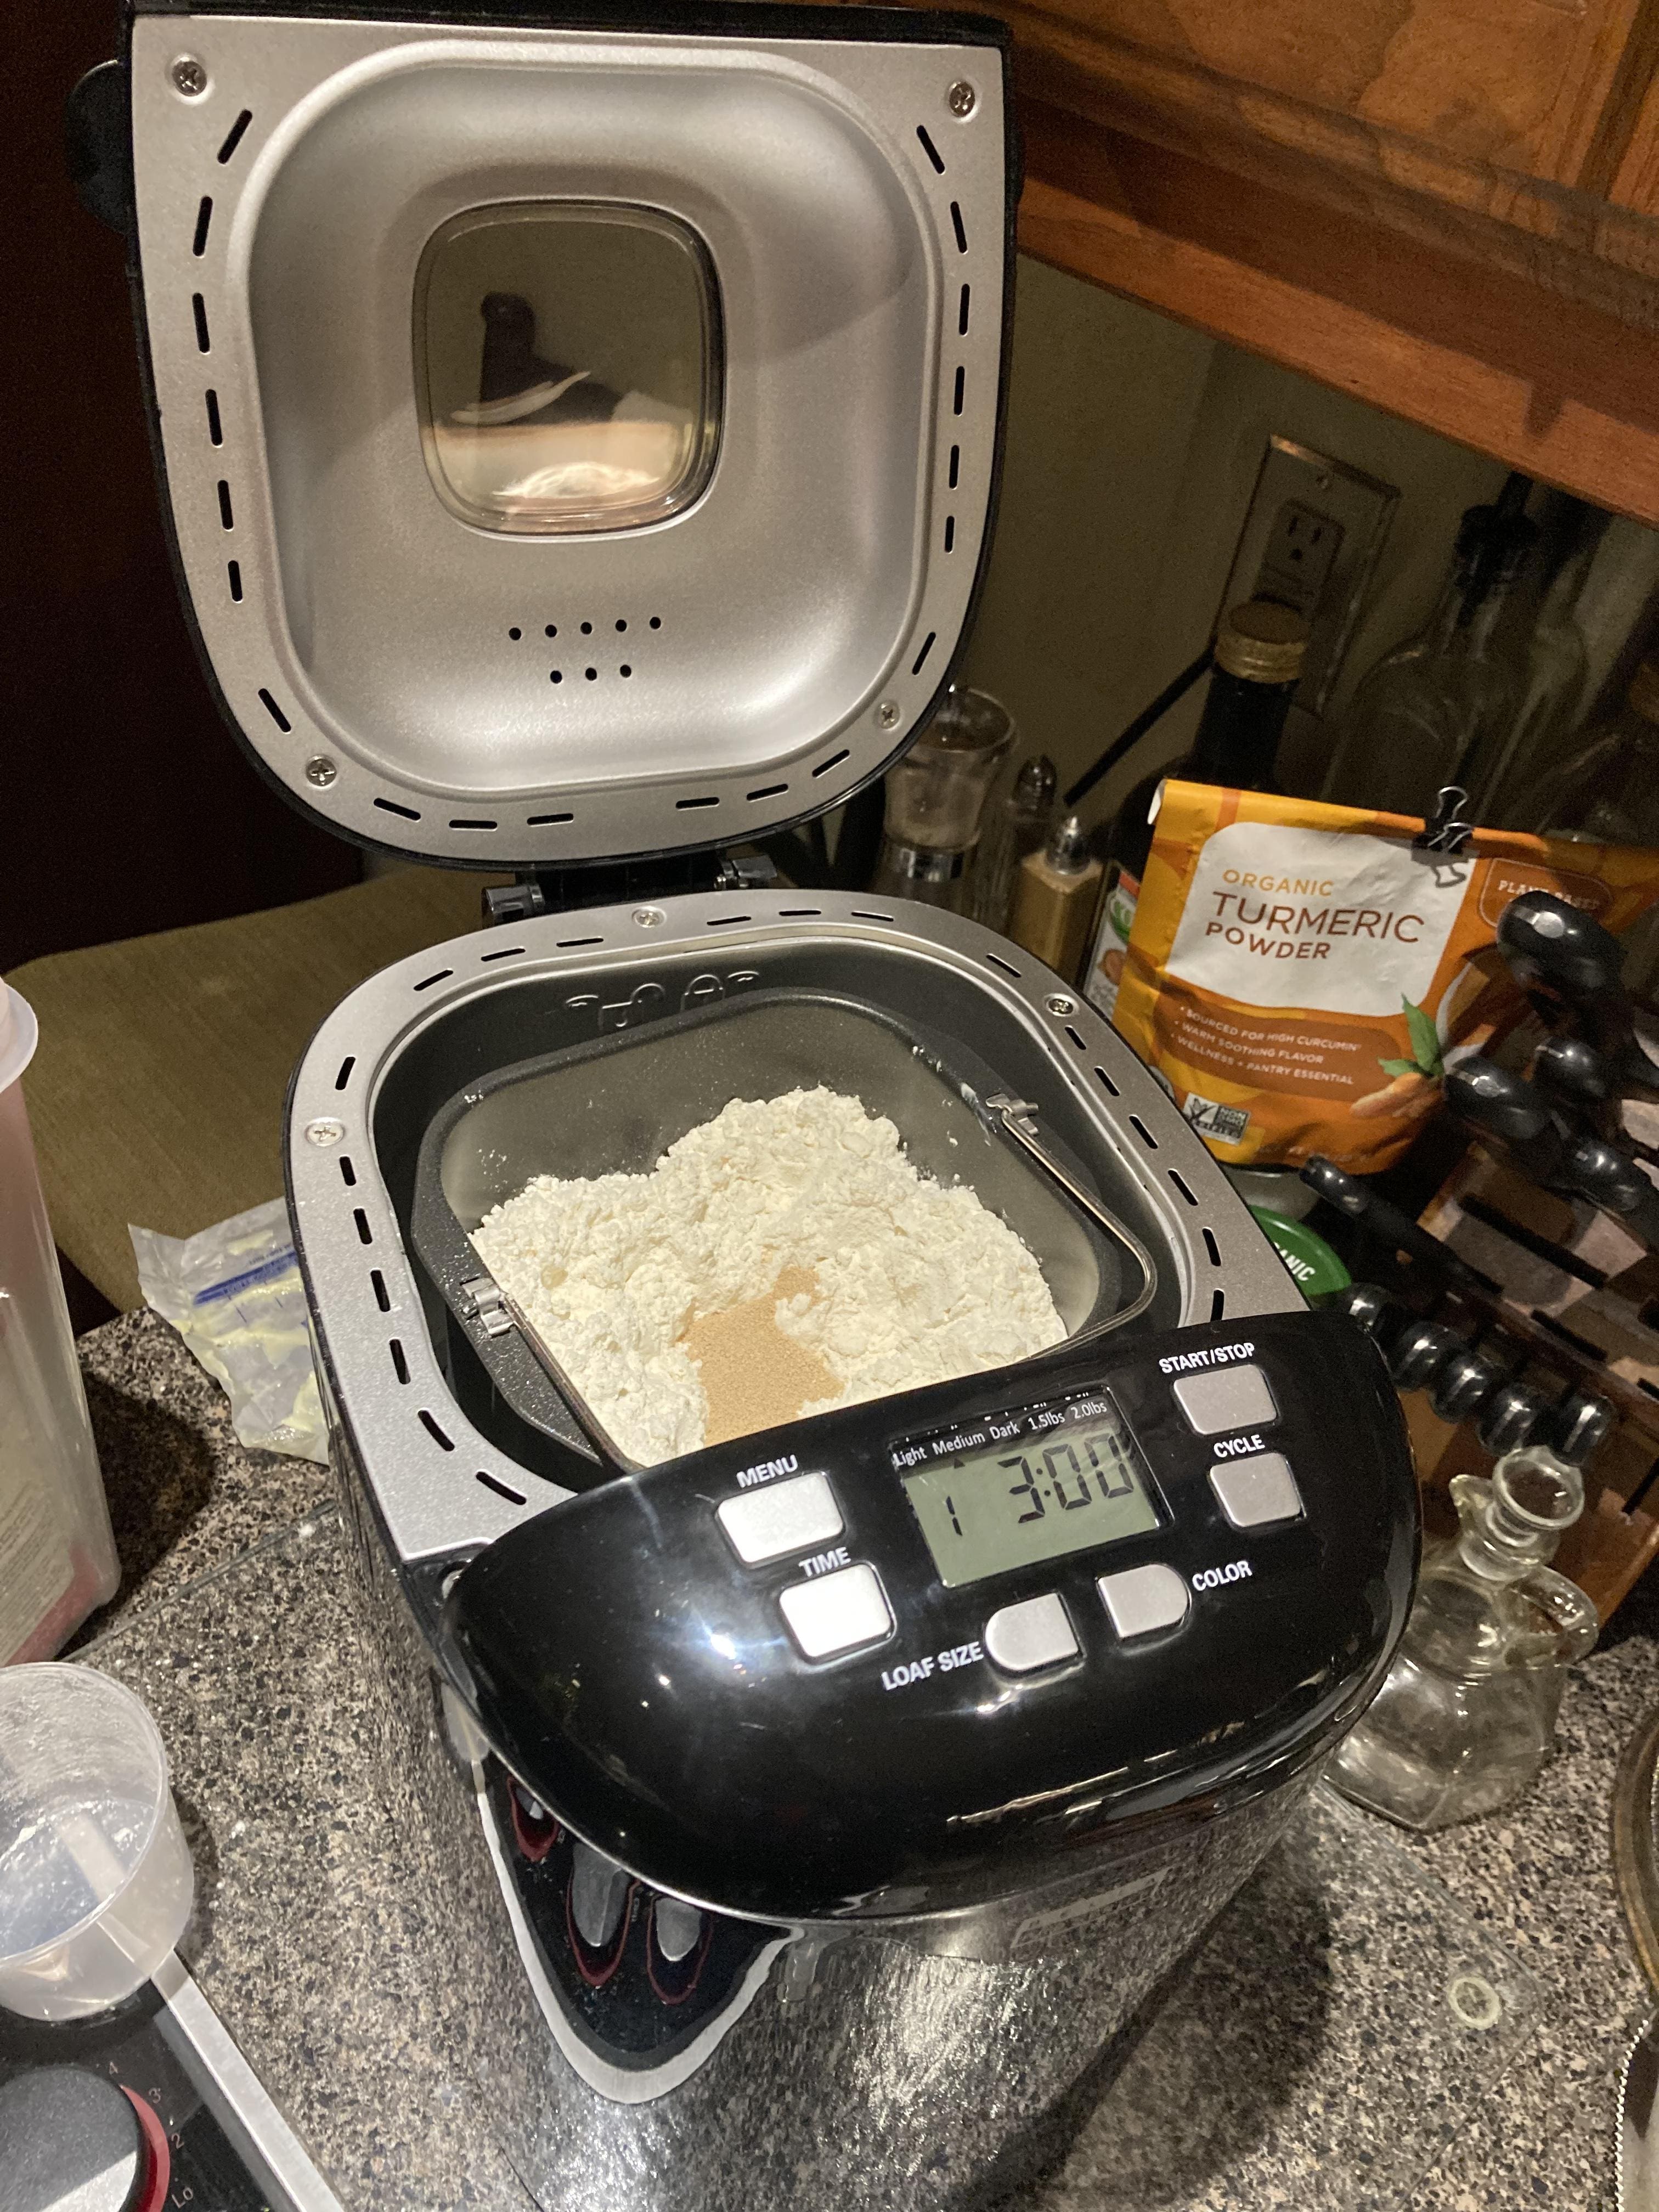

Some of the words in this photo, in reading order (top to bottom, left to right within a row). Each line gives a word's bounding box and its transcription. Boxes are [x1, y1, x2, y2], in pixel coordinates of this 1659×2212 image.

[1223, 869, 1335, 896] ORGANIC
[1213, 891, 1424, 943] TURMERIC
[1206, 922, 1331, 959] POWDER
[1187, 1009, 1238, 1035] SOURCED
[1241, 1029, 1265, 1041] FOR
[1267, 1033, 1295, 1043] HIGH
[1177, 1036, 1234, 1065] WELLNESS
[1246, 1062, 1291, 1076] PANTRY
[1294, 1069, 1353, 1085] ESSENTIAL
[1182, 1023, 1216, 1042] WARM
[1218, 1038, 1276, 1057] SOOTHING
[1278, 1049, 1324, 1064] FLAVOR
[1273, 1242, 1316, 1281] ANIC
[1159, 1342, 1255, 1373] START/STOP
[894, 1446, 927, 1467] Light
[932, 1432, 985, 1455] Medium
[990, 1421, 1020, 1440] Dark
[1028, 1410, 1065, 1430] 1.5lbs
[1071, 1400, 1107, 1420] 2.0lbs
[1214, 1434, 1265, 1458] CYCLE
[736, 1454, 798, 1488] MENU
[946, 1496, 963, 1536] 1
[997, 1433, 1134, 1523] 3:00
[799, 1547, 851, 1577] TIME
[1192, 1560, 1252, 1591] COLOR
[881, 1656, 935, 1690] LOAF
[938, 1641, 984, 1672] SIZE
[148, 2087, 161, 2103] 3
[171, 2132, 184, 2149] 2
